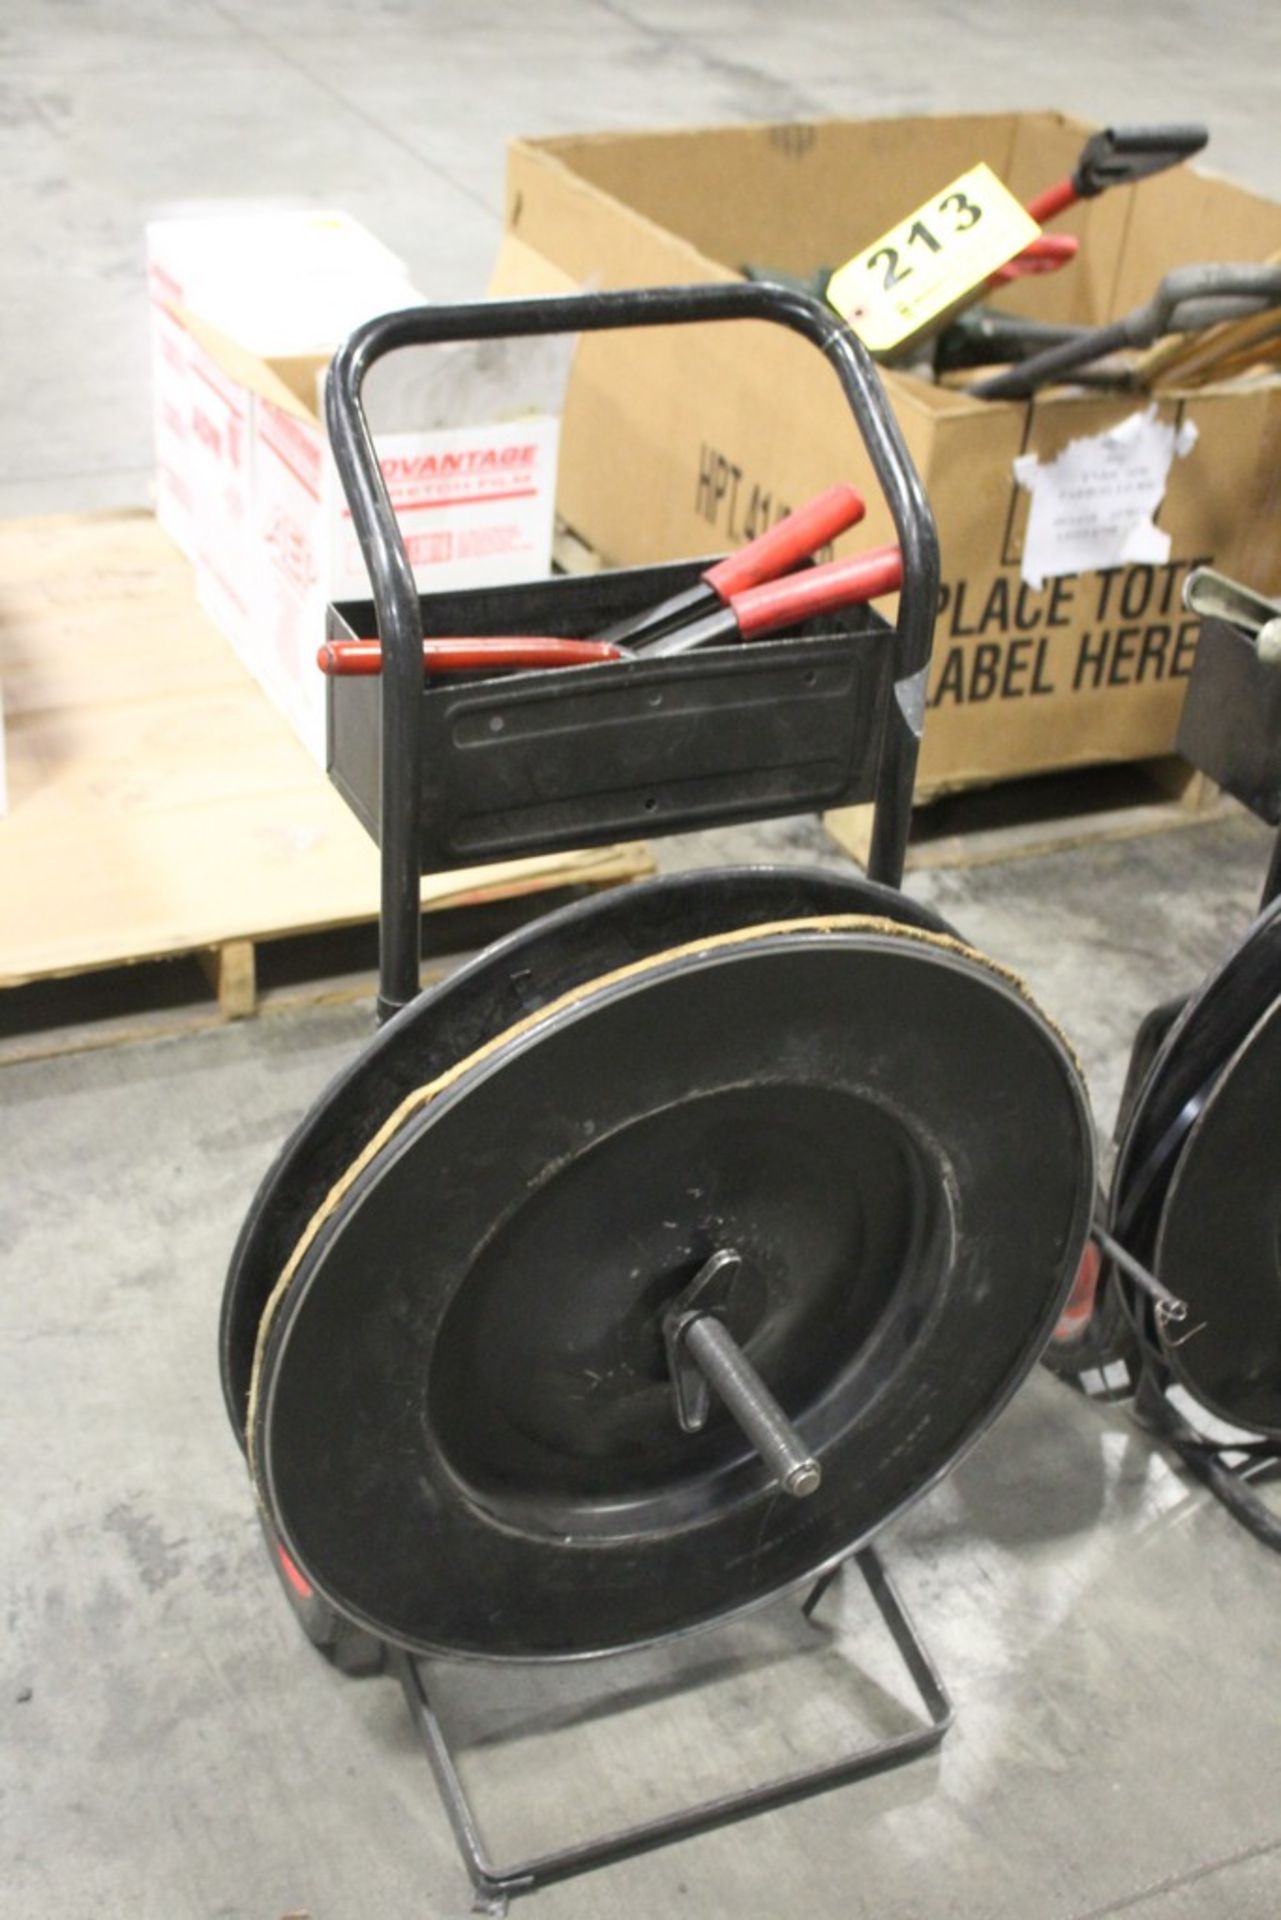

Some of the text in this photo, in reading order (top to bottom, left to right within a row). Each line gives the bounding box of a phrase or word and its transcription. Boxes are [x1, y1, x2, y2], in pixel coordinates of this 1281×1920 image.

[867, 192, 982, 291] 213
[379, 444, 538, 479] DVANTAGE
[925, 621, 1200, 708] ABEL HERE
